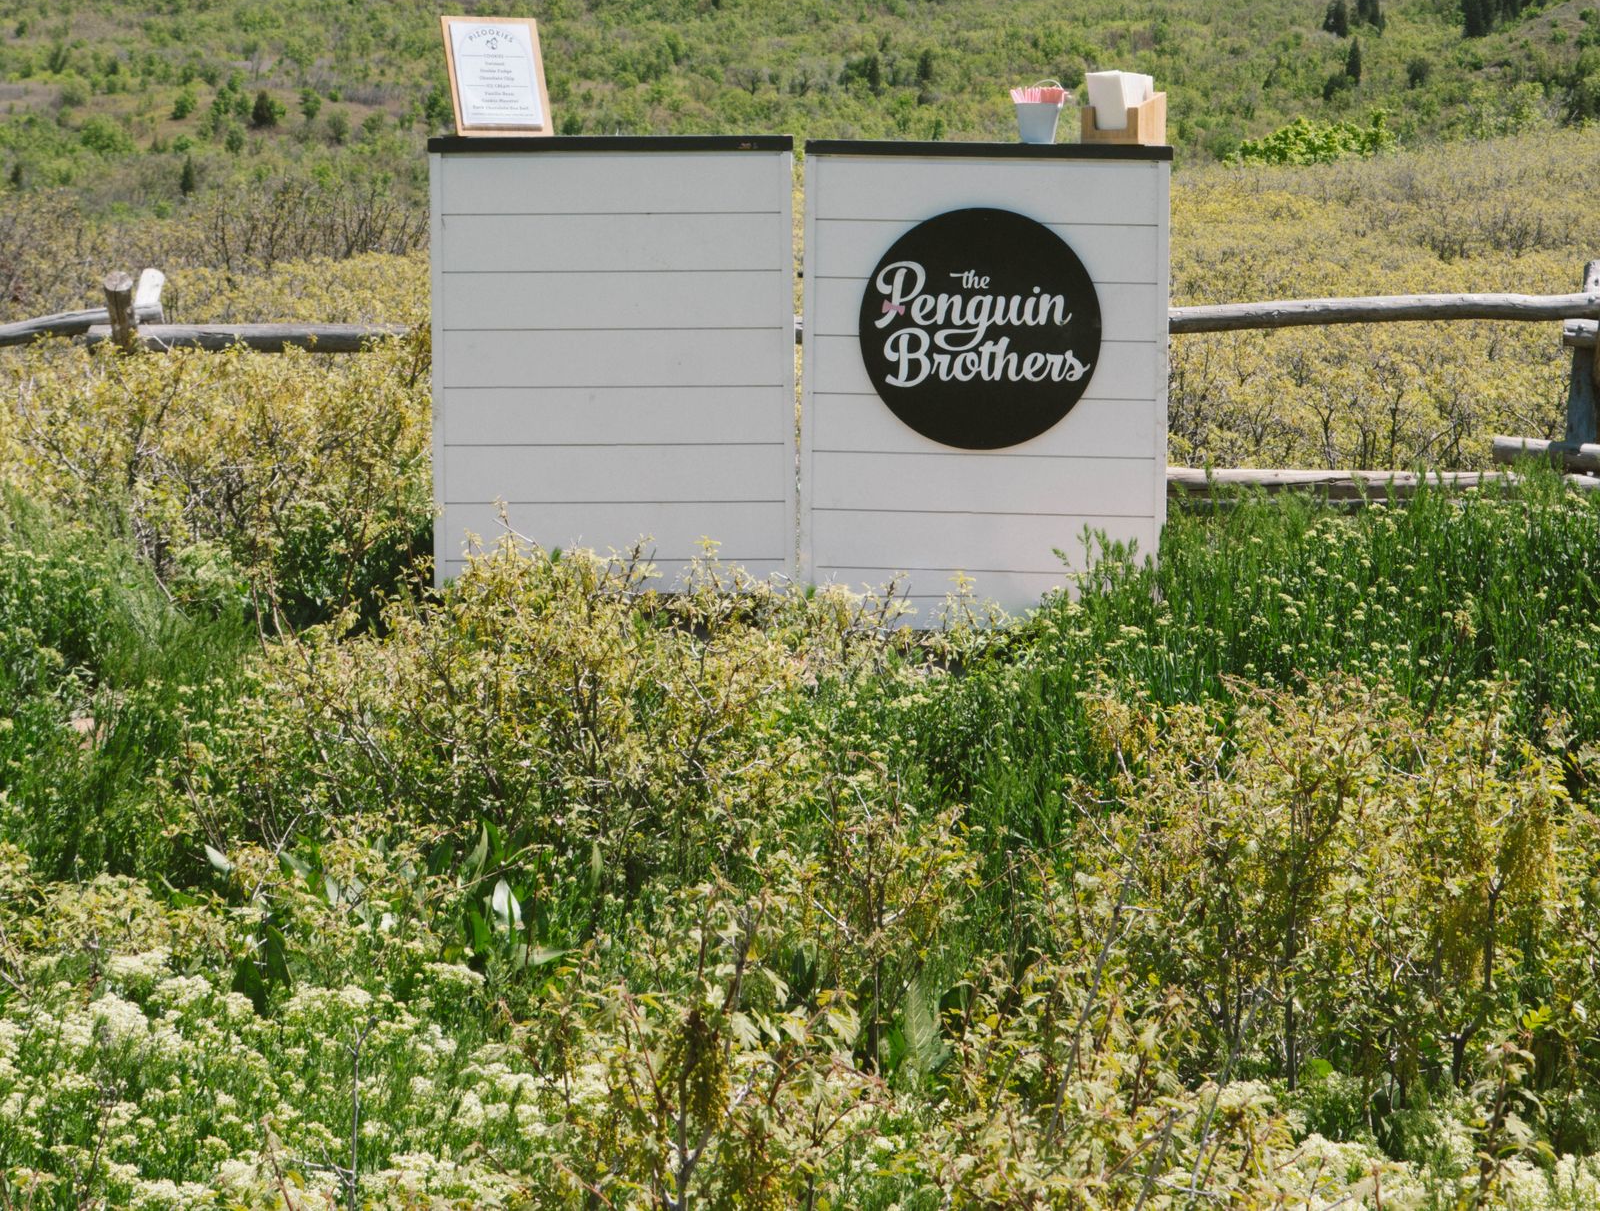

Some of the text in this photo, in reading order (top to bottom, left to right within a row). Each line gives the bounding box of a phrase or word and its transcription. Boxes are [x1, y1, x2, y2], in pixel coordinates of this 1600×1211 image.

[874, 260, 1072, 351] Penguin
[949, 269, 990, 289] the
[883, 327, 1090, 387] Brothers
